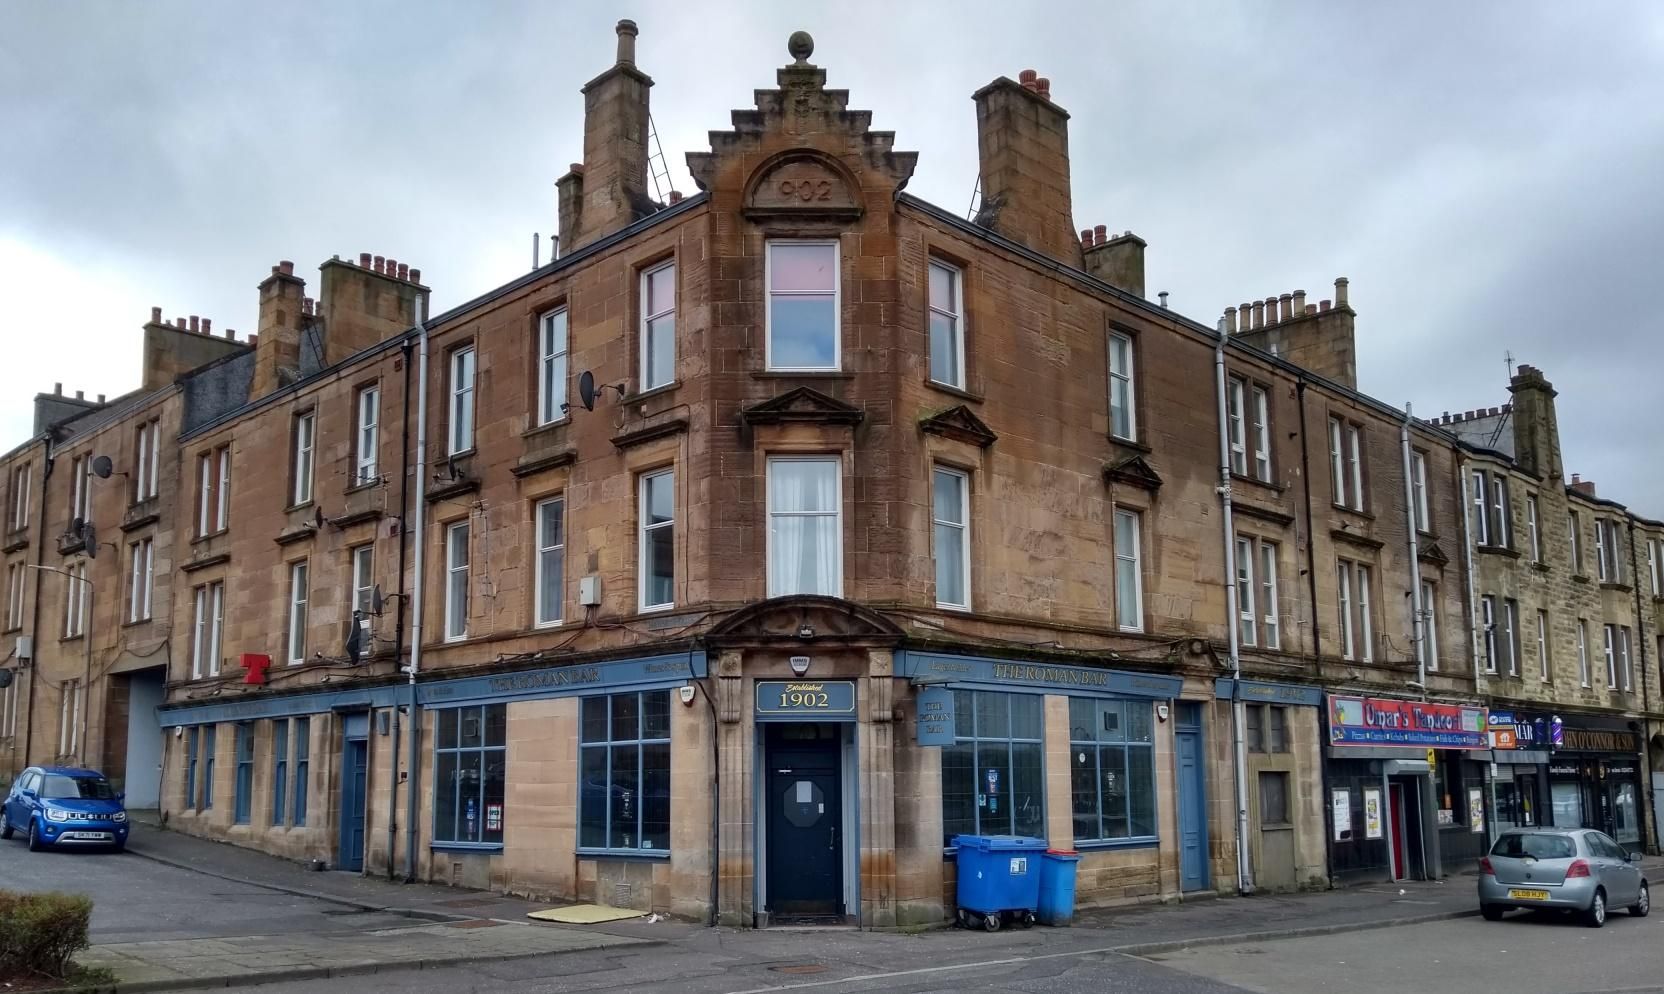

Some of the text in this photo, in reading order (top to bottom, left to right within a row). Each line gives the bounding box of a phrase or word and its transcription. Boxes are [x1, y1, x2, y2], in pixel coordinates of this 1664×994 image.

[489, 667, 600, 692] THE ROMAN BAR
[993, 663, 1023, 680] THE
[1024, 666, 1079, 684] ROMAN
[1080, 671, 1108, 686] BAR
[785, 683, 824, 692] Established
[779, 693, 829, 707] 1902
[926, 702, 944, 710] THE
[920, 713, 951, 722] ROMAN
[1413, 706, 1462, 731] Tandoori
[926, 725, 944, 734] BAR
[1578, 731, 1615, 750] O'CONNOR
